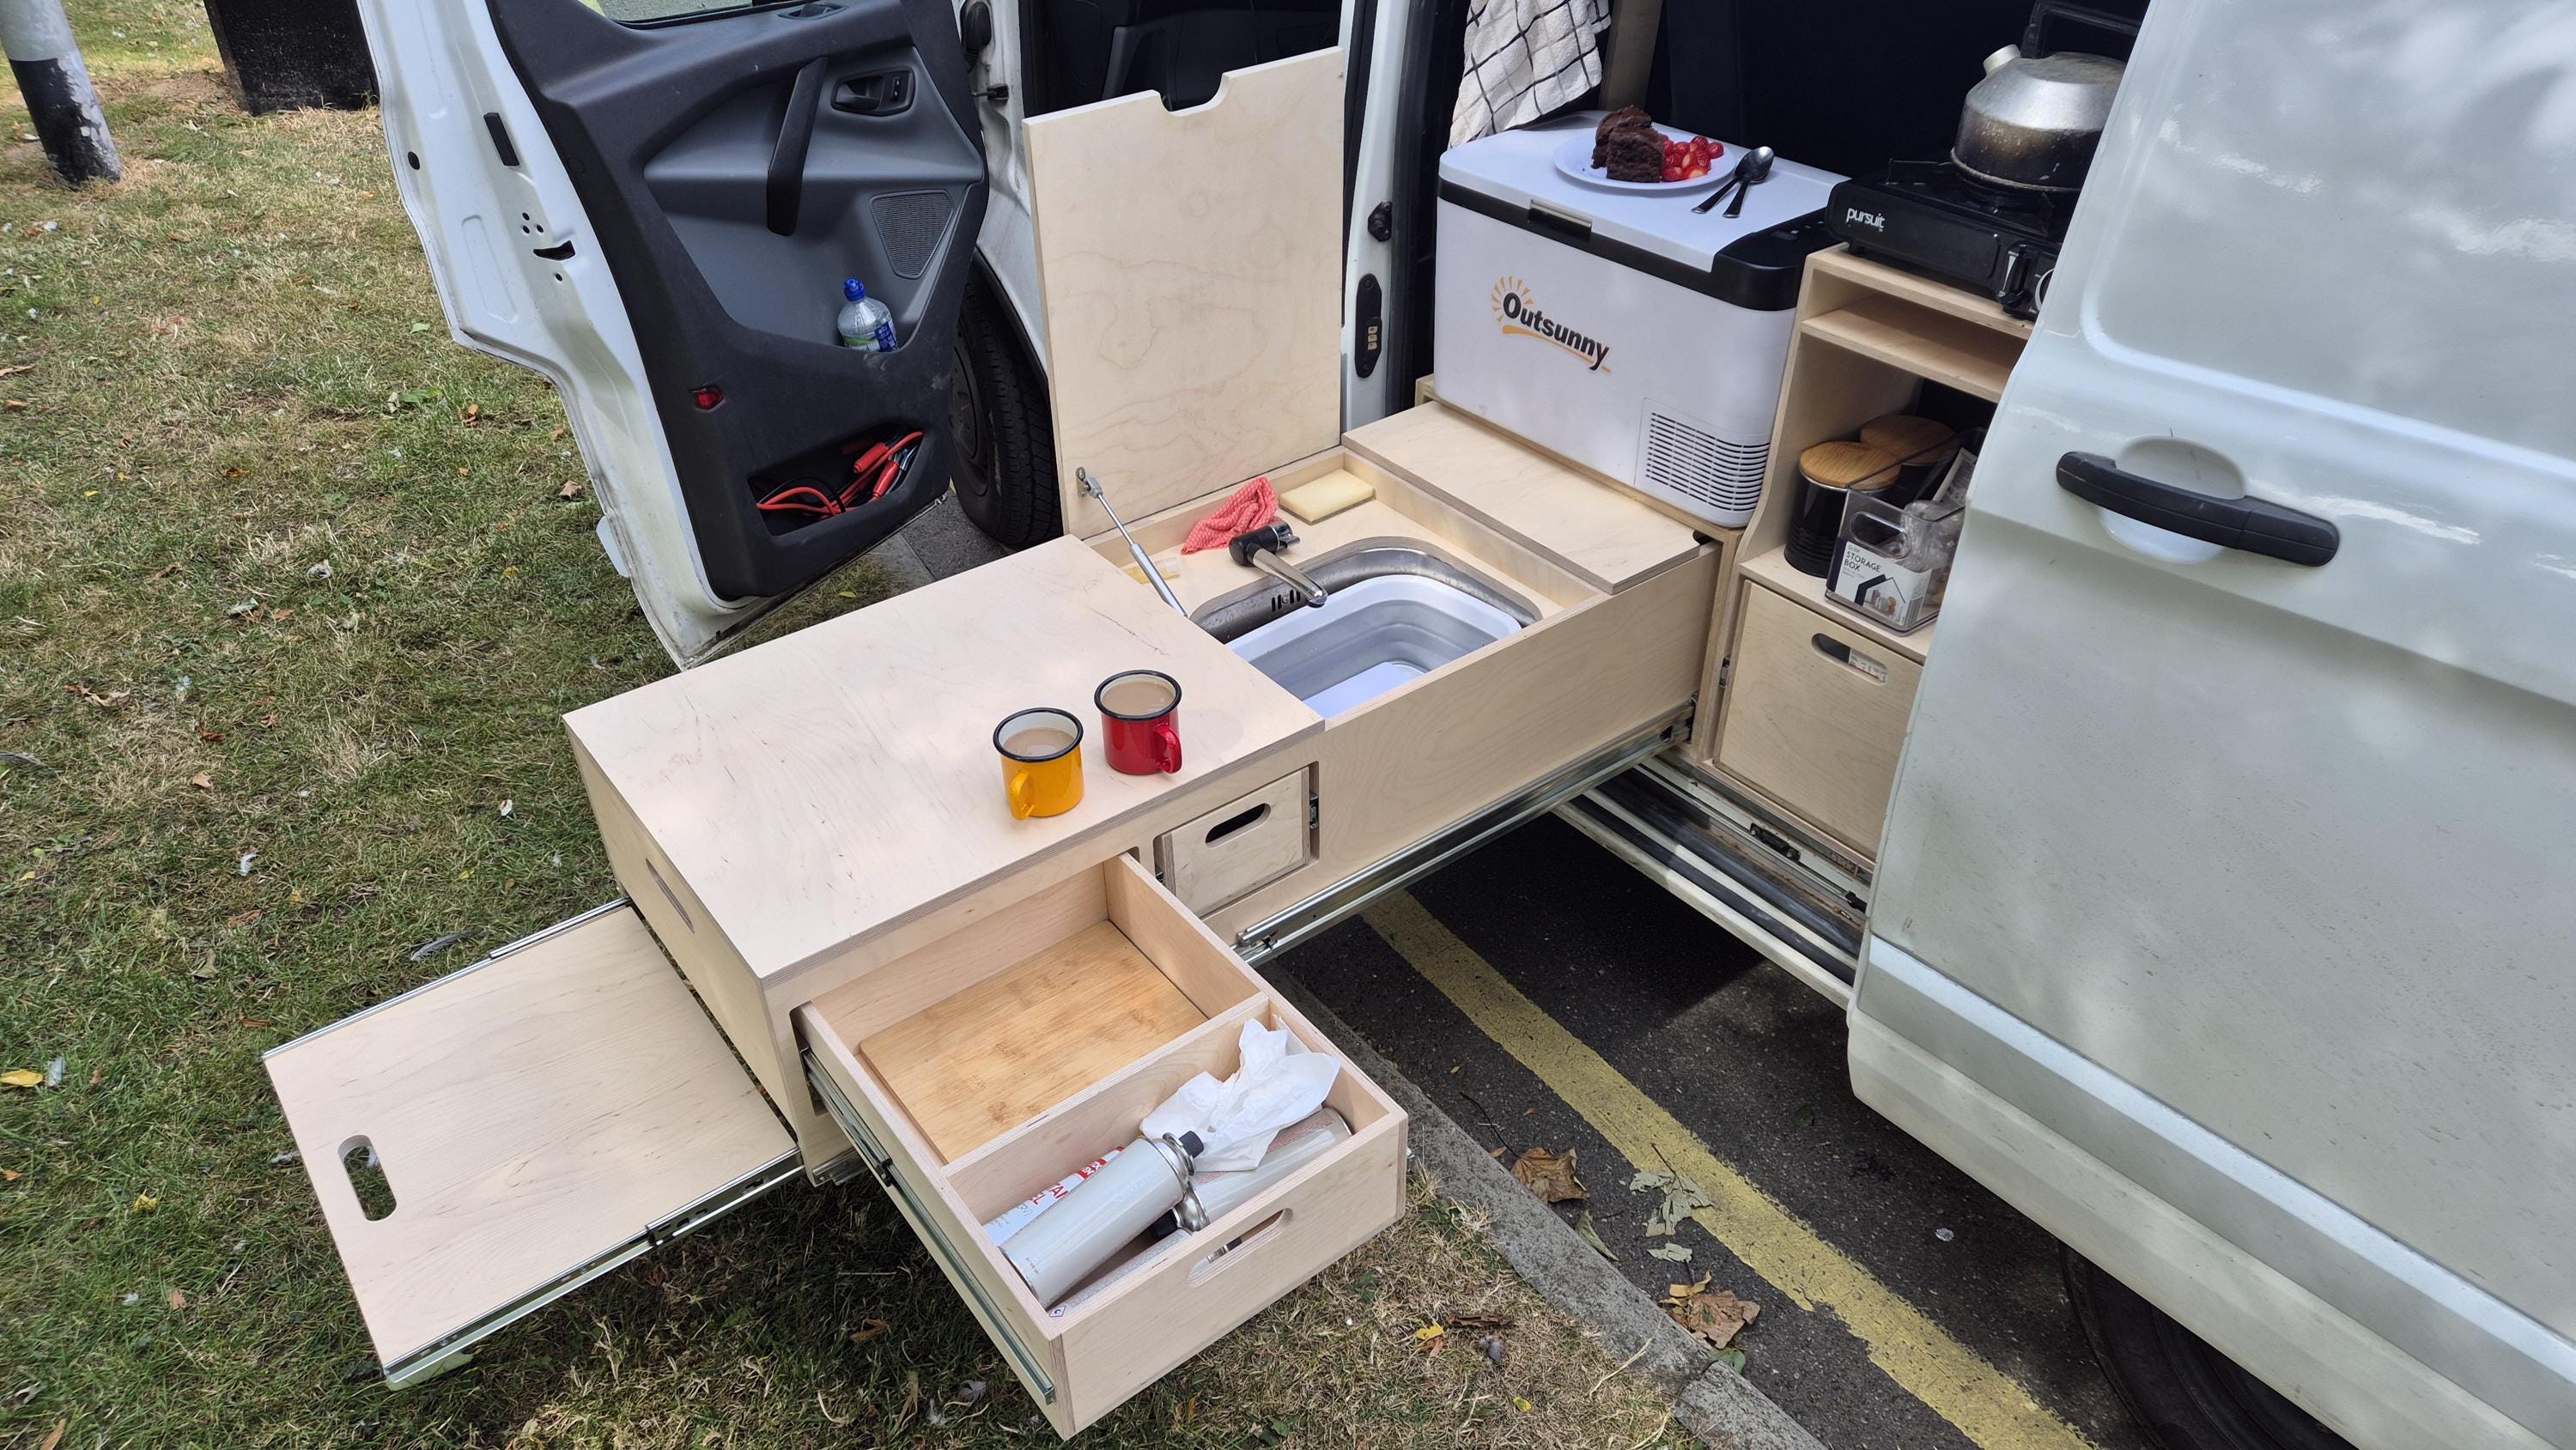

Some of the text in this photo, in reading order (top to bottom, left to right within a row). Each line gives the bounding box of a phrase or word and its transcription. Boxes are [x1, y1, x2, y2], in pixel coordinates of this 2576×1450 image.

[1845, 207, 1886, 228] pursuit
[1503, 292, 1610, 371] Outsunny
[1844, 558, 1862, 572] BOX
[1846, 550, 1882, 573] STORAGE
